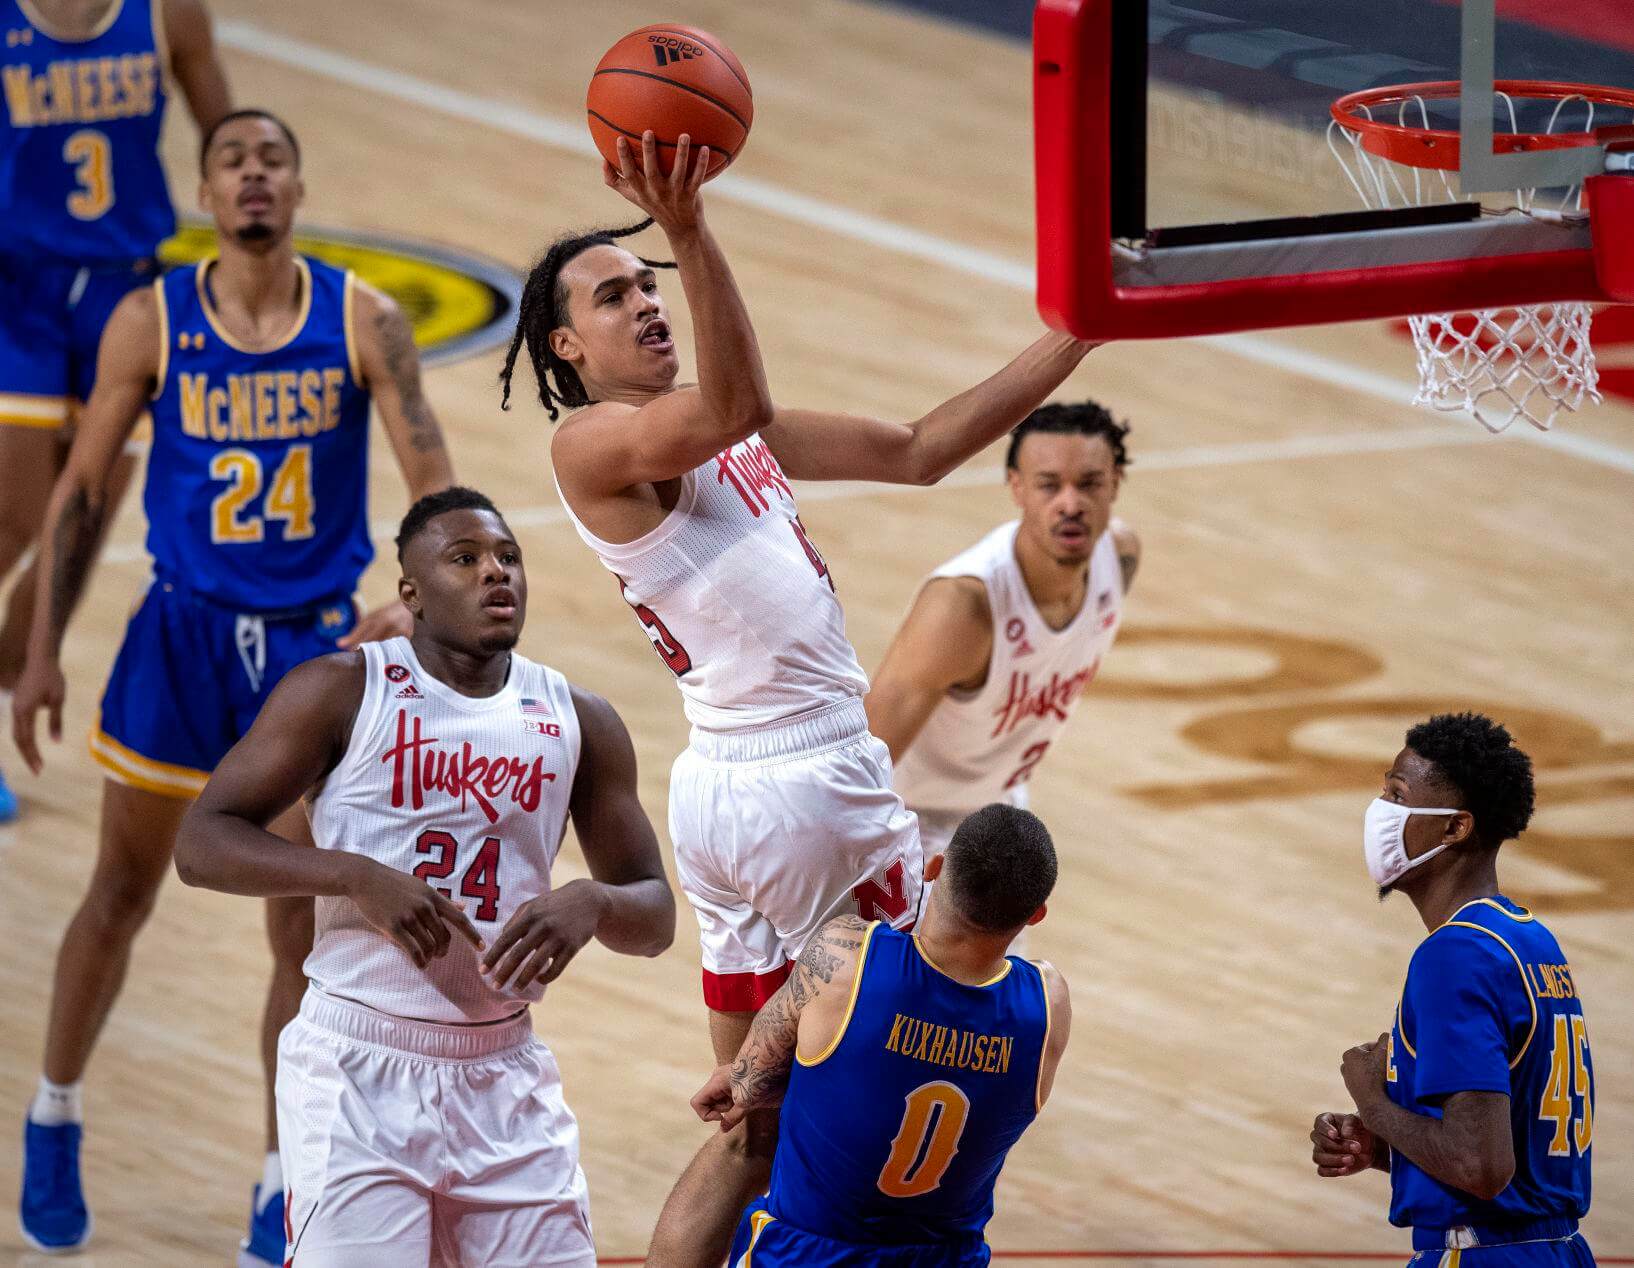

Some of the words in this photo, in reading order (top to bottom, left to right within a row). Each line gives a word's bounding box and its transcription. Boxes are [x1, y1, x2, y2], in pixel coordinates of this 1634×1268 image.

[647, 35, 704, 57] adidas
[62, 129, 116, 222] 3
[210, 444, 316, 544] 24
[395, 692, 425, 700] adidas
[382, 708, 557, 825] Huskers
[1002, 740, 1053, 791] 2
[412, 828, 502, 923] 24
[851, 855, 910, 923] N
[885, 1012, 1015, 1075] KUXHAUSEN
[1538, 1013, 1595, 1159] 45
[876, 1079, 971, 1199] 0
